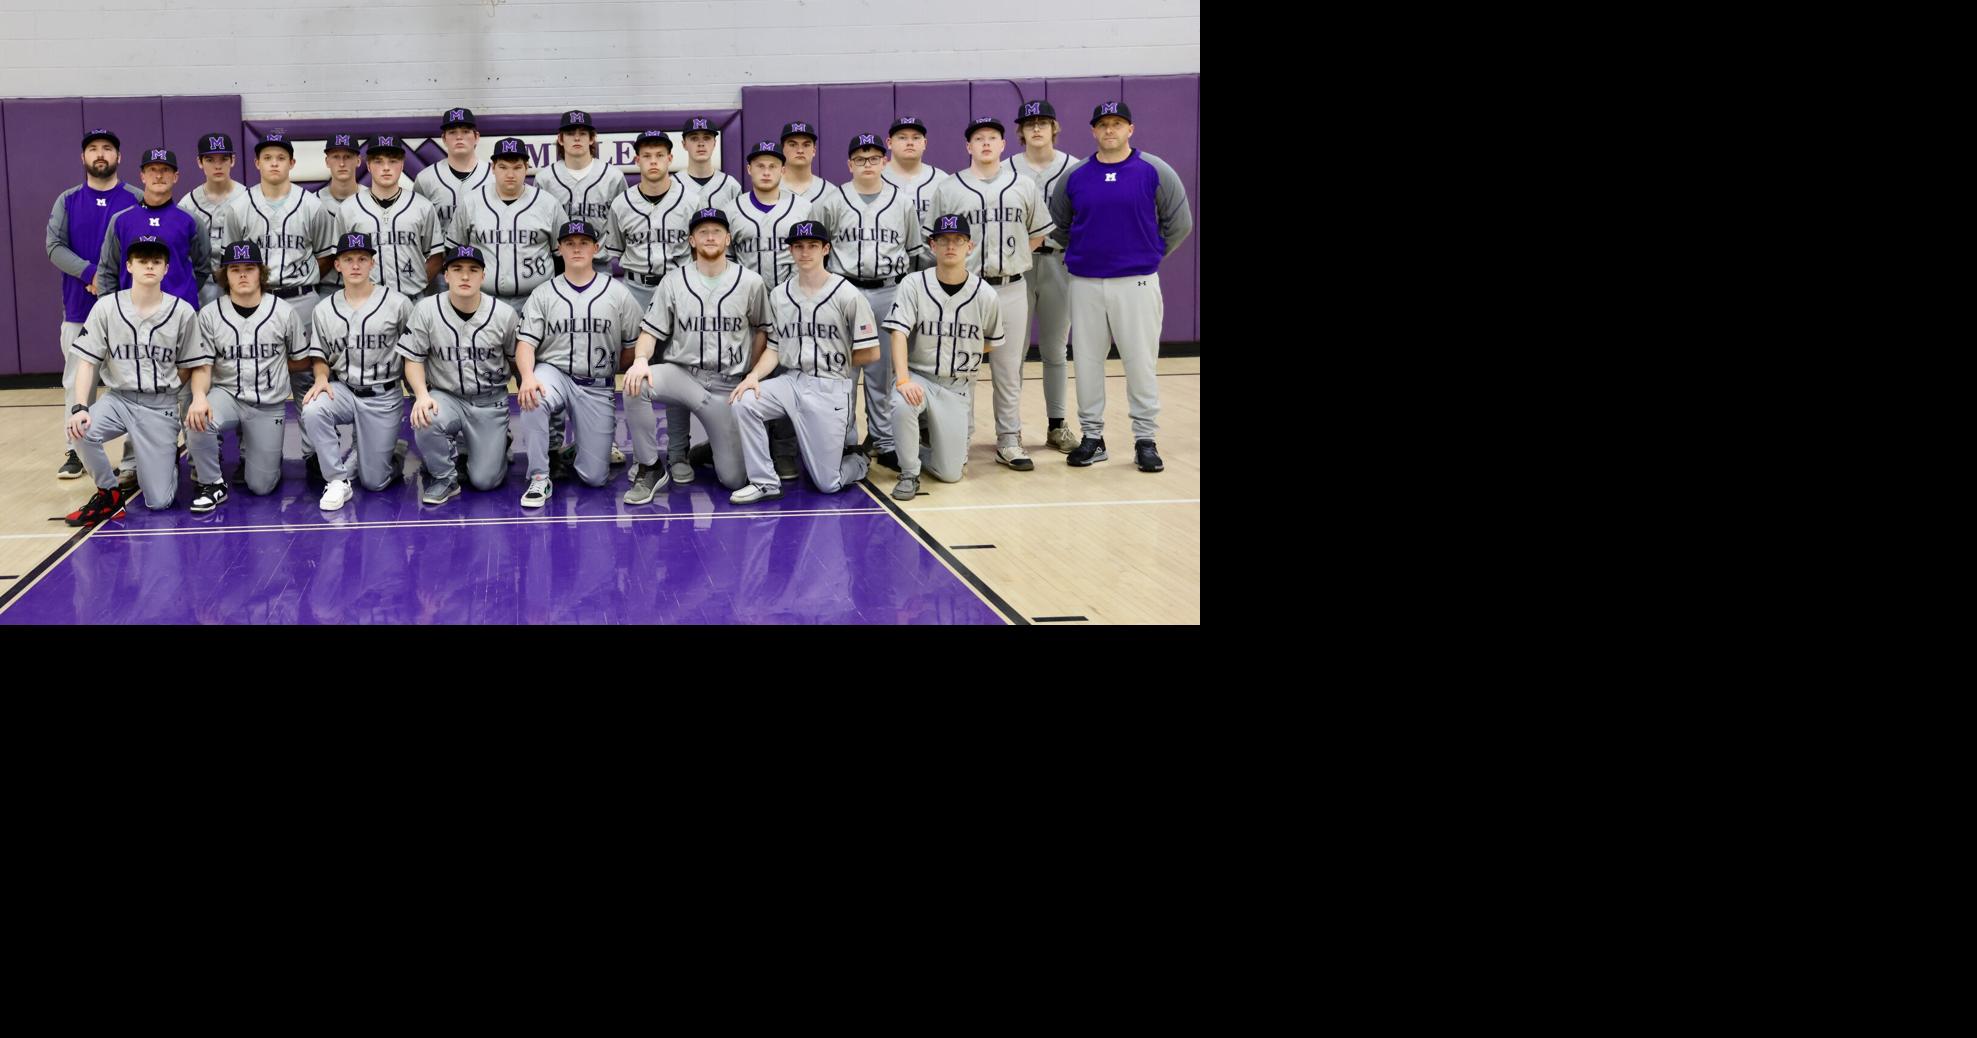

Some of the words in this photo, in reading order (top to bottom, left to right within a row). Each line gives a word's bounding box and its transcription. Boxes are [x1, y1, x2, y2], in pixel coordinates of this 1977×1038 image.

[449, 109, 465, 121] M
[1024, 102, 1040, 116] M
[1101, 102, 1118, 115] M
[569, 112, 585, 124] M
[692, 118, 708, 130] M
[791, 123, 806, 133] M
[209, 136, 225, 150] M
[335, 134, 350, 146] M
[378, 136, 393, 147] M
[759, 141, 775, 151] M
[859, 134, 875, 145] M
[502, 140, 518, 153] M
[151, 149, 167, 161] M
[1105, 172, 1117, 182] M
[96, 198, 107, 207] M
[700, 208, 717, 218] M
[149, 217, 160, 227] M
[568, 222, 585, 234] M
[941, 216, 958, 229] M
[796, 223, 813, 236] M
[836, 227, 900, 245] MILLER
[347, 234, 365, 248] M
[474, 229, 540, 245] MILLER
[233, 244, 250, 259] M
[457, 246, 474, 257] M
[735, 237, 786, 253] MILLE
[1007, 236, 1017, 257] 9
[402, 259, 414, 277] 4
[547, 318, 612, 335] MILLER
[678, 316, 742, 332] MILLER
[776, 322, 841, 339] MILLER
[917, 320, 980, 340] MILLER
[107, 343, 174, 362] MILLER
[432, 345, 497, 362] MILLER
[824, 352, 847, 372] 19
[957, 351, 982, 372] 22
[369, 361, 392, 380] 11
[263, 369, 274, 391] 1
